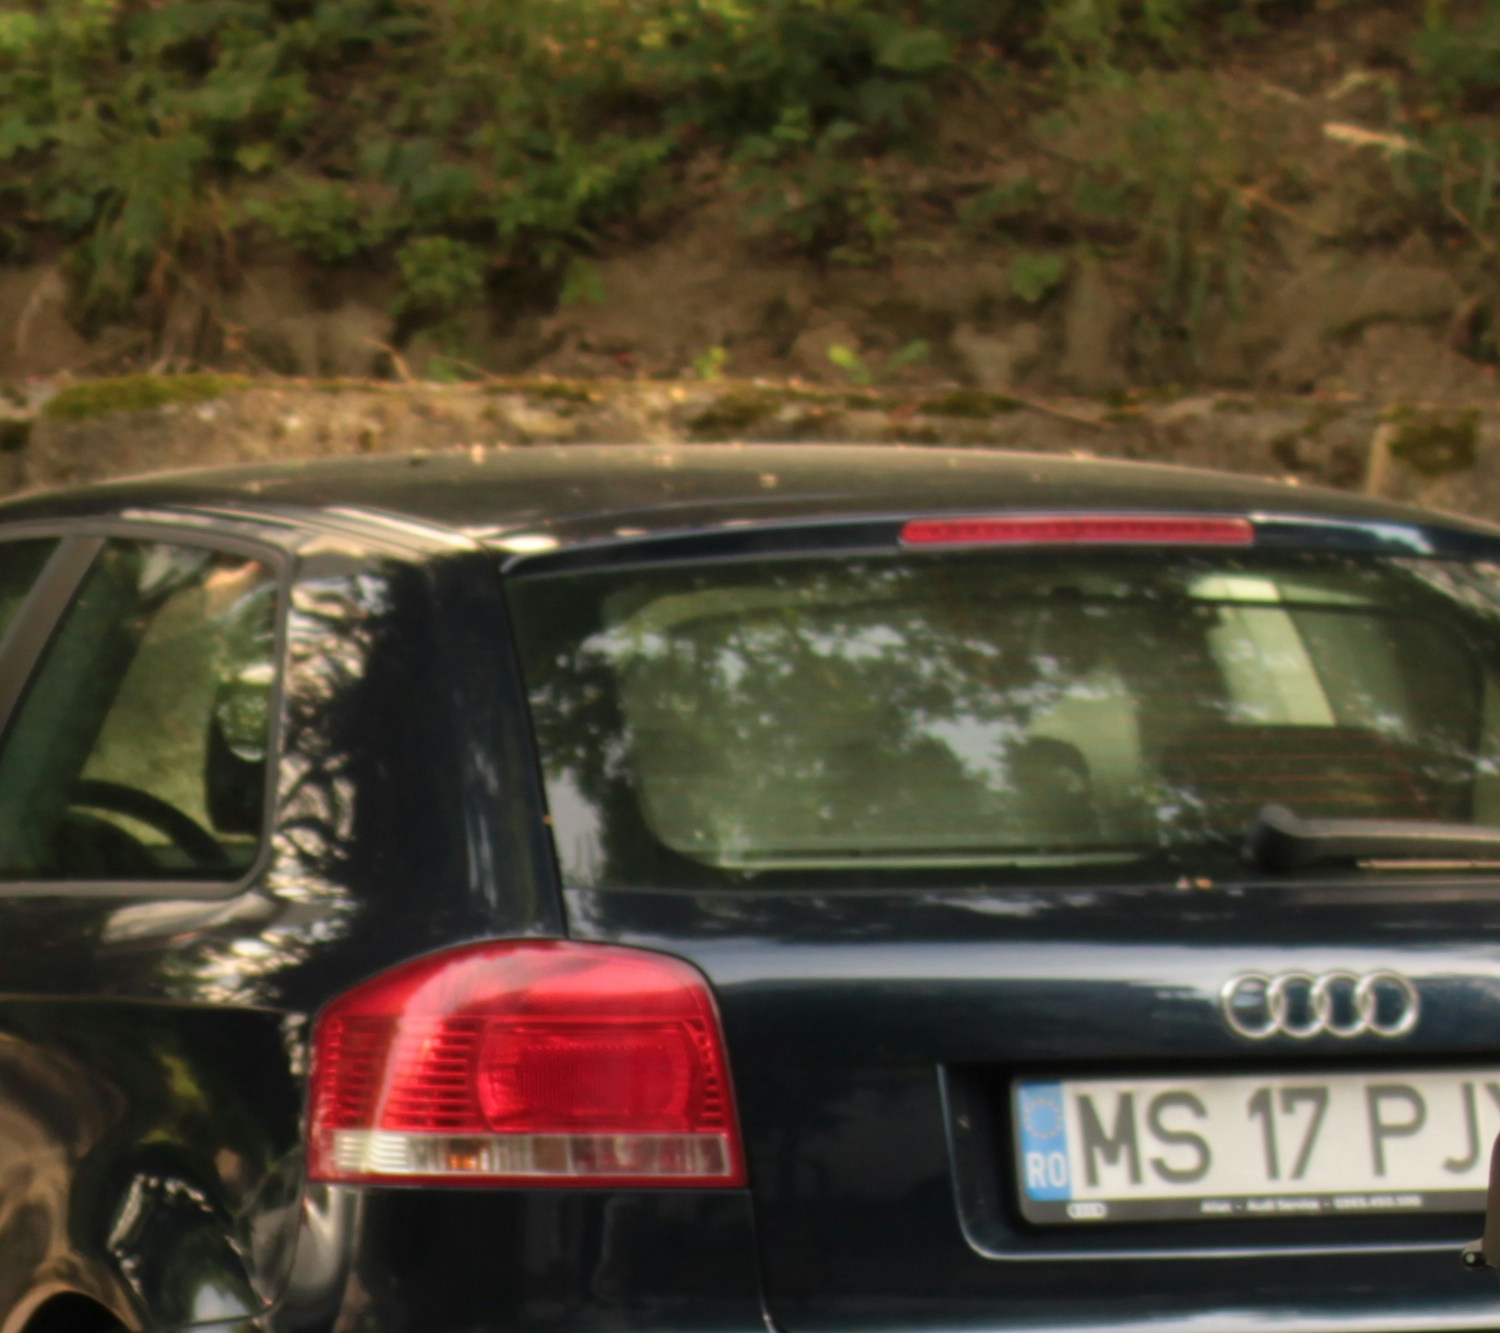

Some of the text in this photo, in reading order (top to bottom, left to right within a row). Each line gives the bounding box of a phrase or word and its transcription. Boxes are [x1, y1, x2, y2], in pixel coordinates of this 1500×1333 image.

[1027, 1152, 1068, 1188] RO
[1076, 1090, 1212, 1187] MS
[1248, 1086, 1329, 1181] 17
